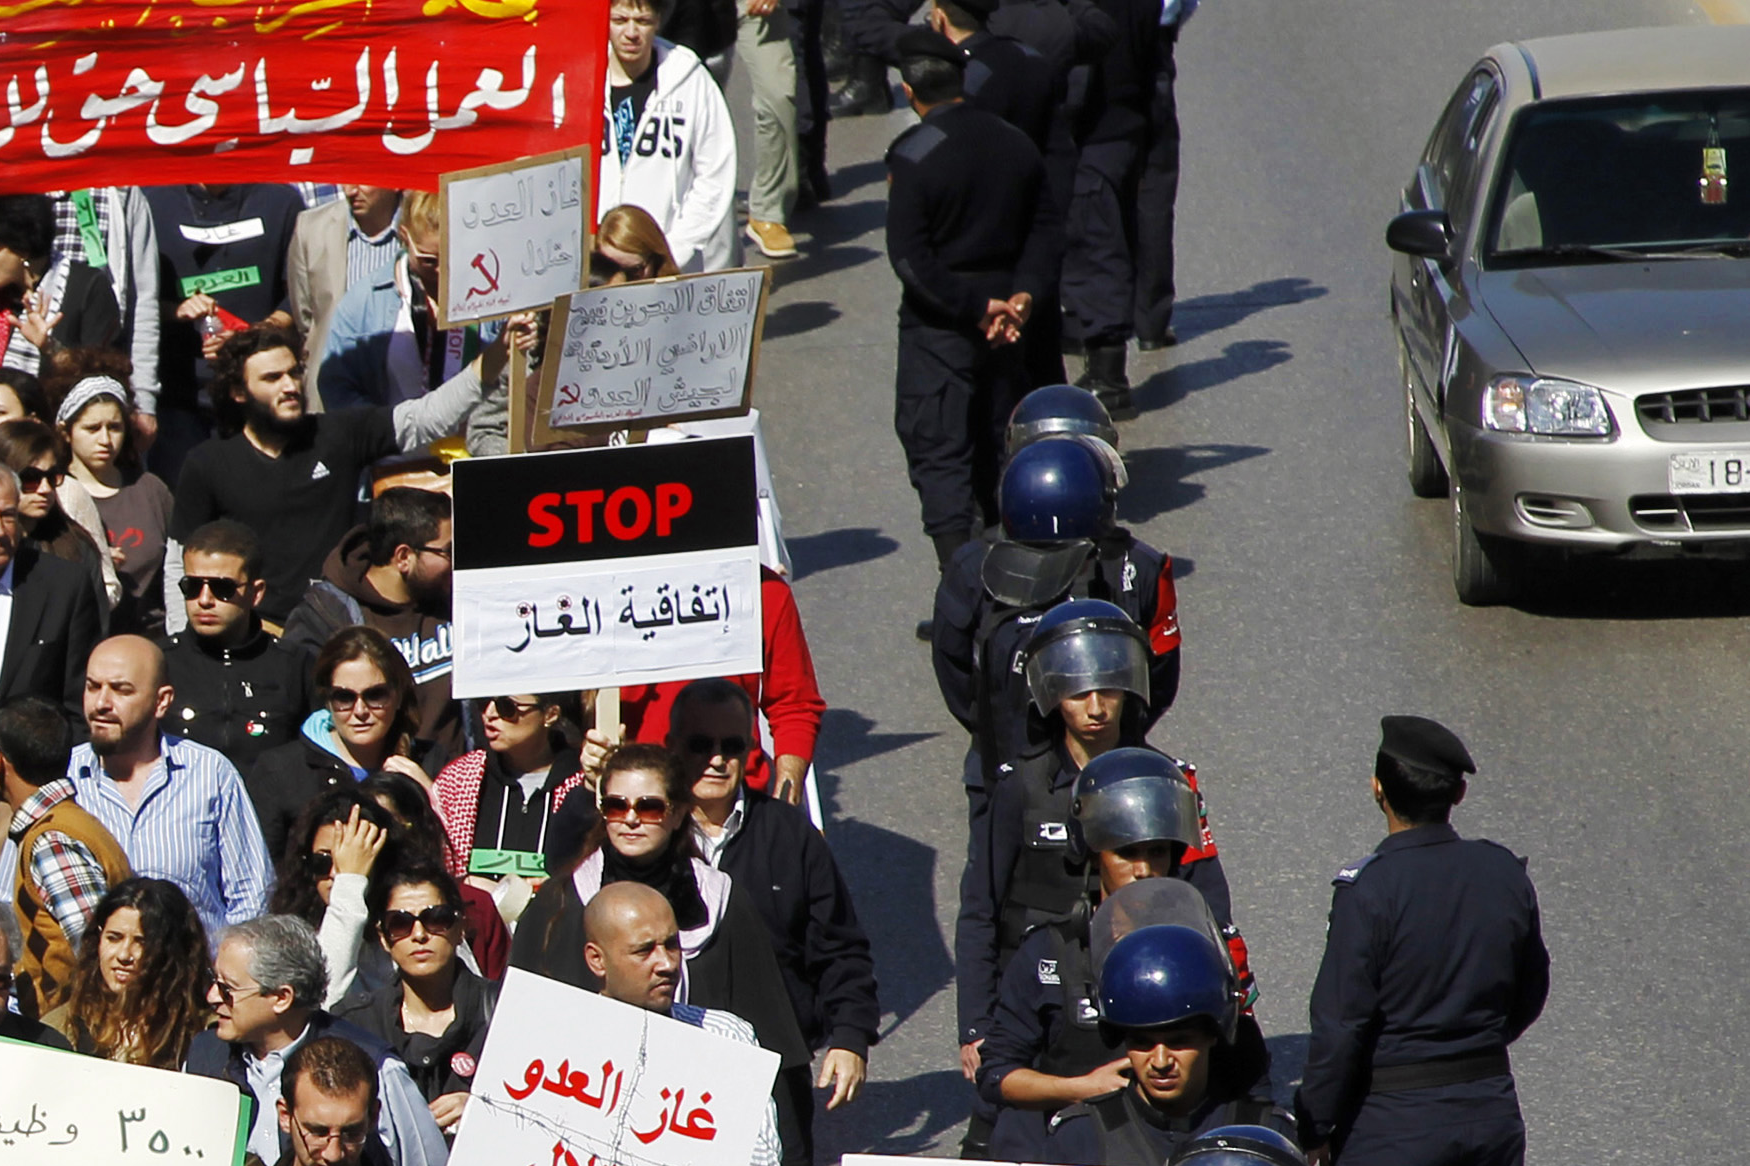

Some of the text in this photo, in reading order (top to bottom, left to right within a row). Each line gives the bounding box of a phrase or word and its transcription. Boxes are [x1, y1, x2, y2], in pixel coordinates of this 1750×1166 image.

[461, 176, 535, 229] العدو
[527, 482, 693, 548] STOP
[505, 583, 731, 654] إتفاقية الغاز
[503, 1059, 718, 1145] غاز العدو
